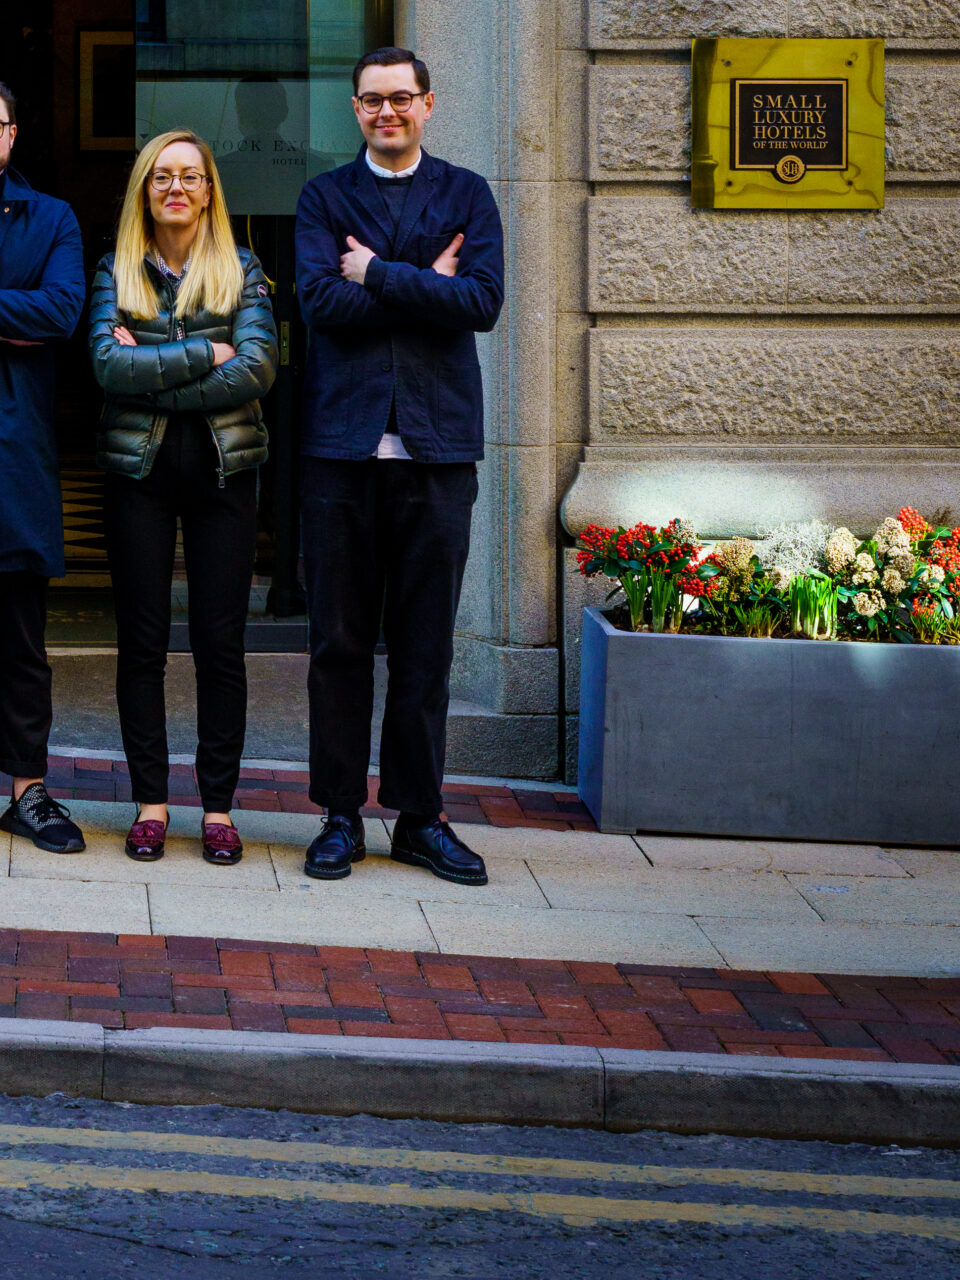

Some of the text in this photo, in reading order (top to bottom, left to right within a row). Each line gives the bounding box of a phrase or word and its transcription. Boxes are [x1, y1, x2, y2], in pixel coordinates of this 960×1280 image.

[753, 94, 827, 109] SMALL
[753, 110, 827, 124] LUXURY
[752, 125, 827, 140] HOTELS
[208, 138, 262, 152] TOCK
[753, 141, 766, 150] OF
[768, 141, 788, 150] THE
